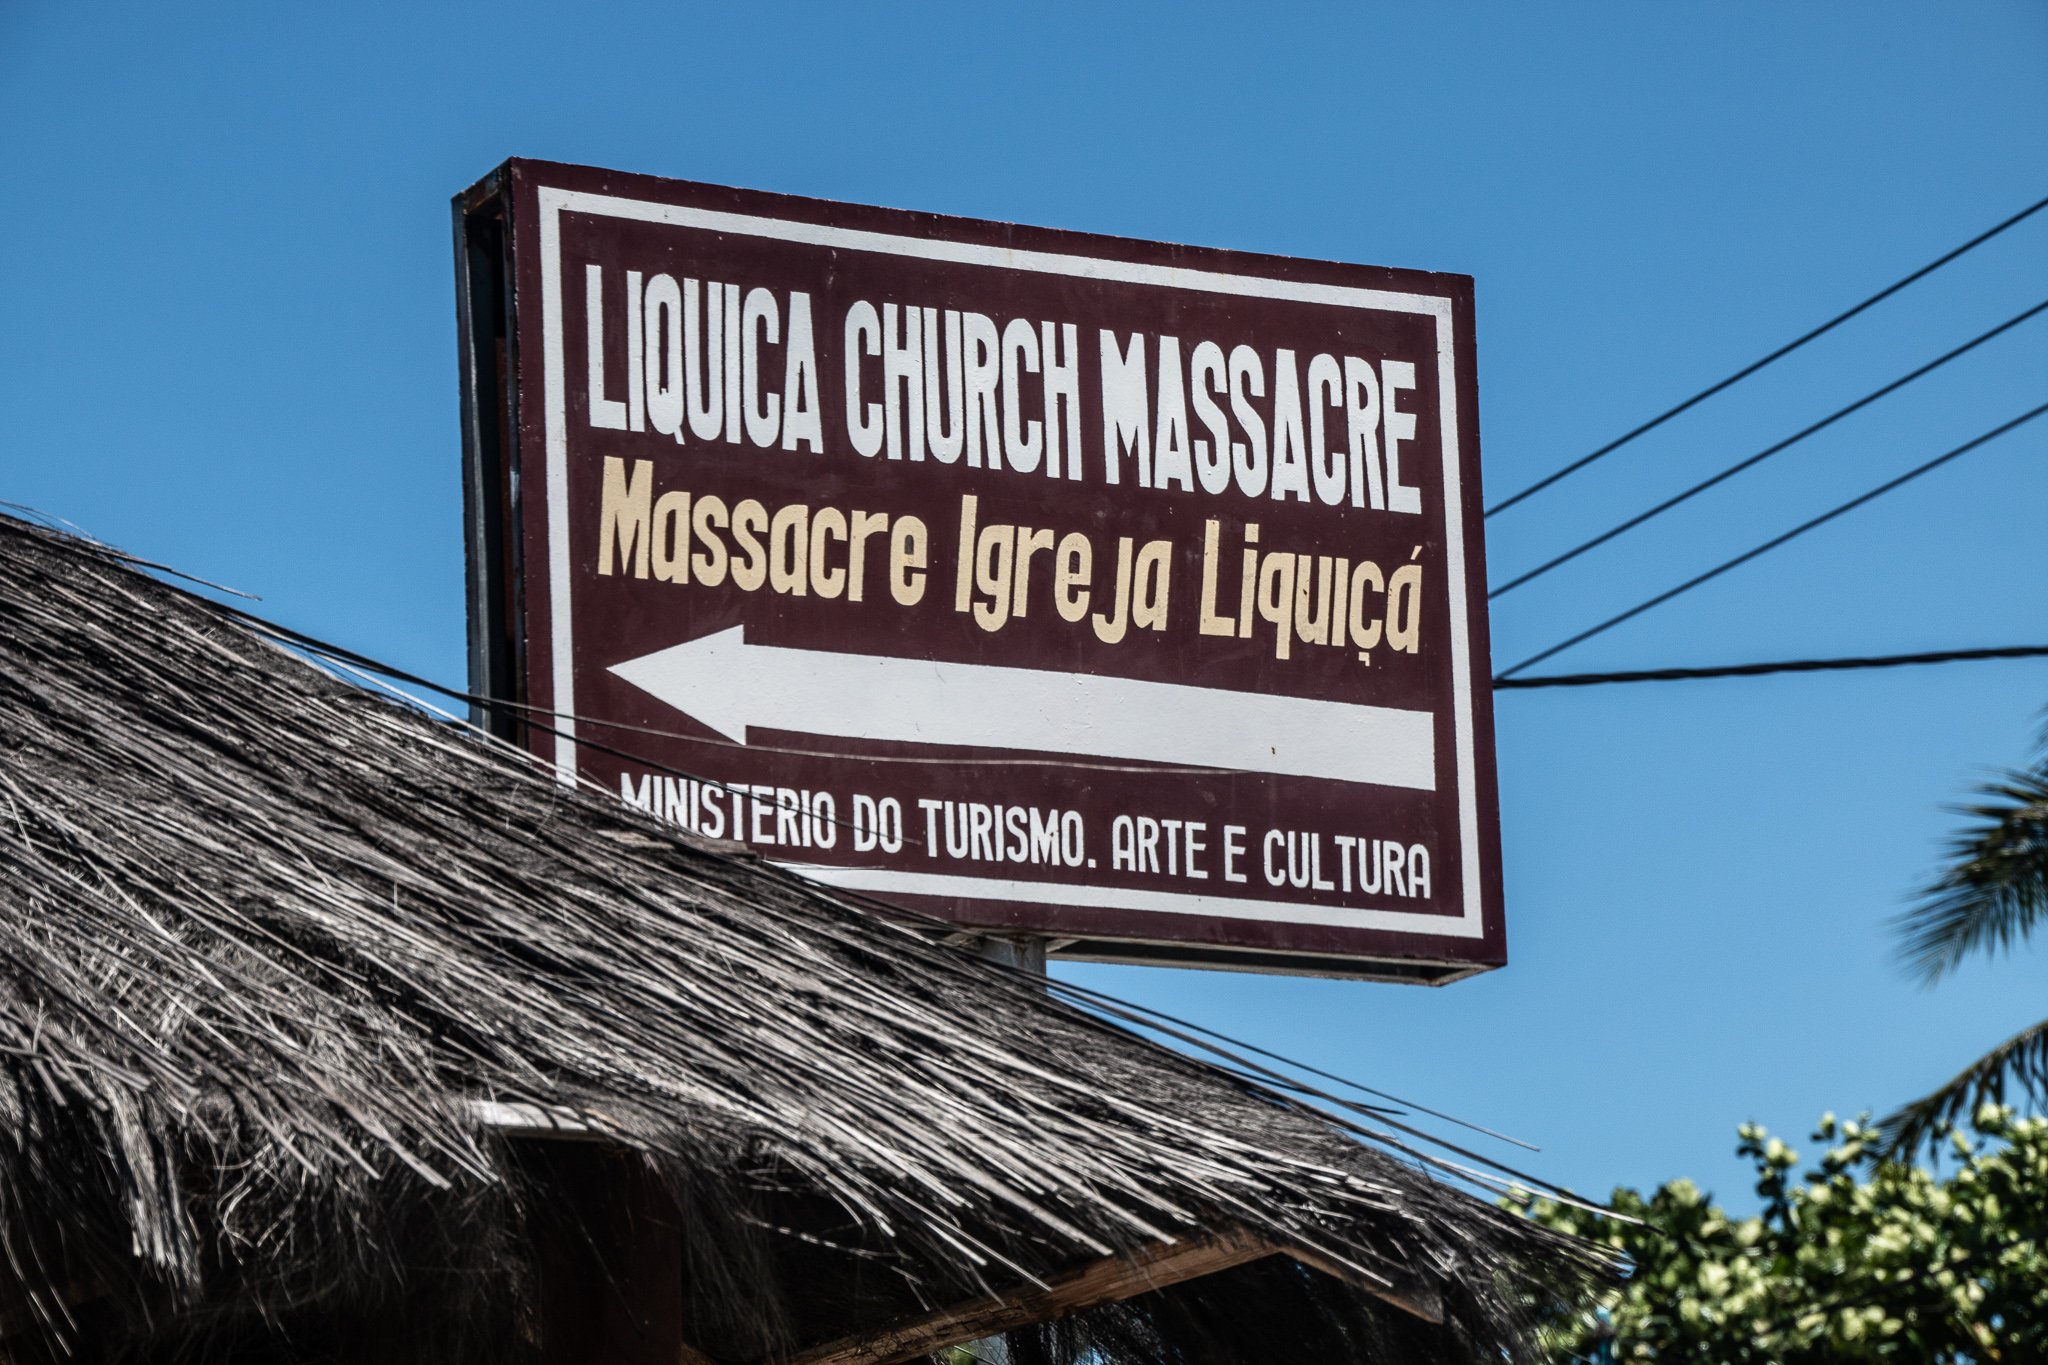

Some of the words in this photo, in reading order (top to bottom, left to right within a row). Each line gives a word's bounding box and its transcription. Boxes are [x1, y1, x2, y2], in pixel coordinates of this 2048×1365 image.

[585, 264, 825, 456] LIQUICA
[844, 299, 1084, 483] CHURCH
[1099, 328, 1423, 516] MASSACRE
[597, 455, 929, 607] Massacre
[852, 793, 904, 854] DO
[917, 798, 1097, 869] TURISMO.
[1111, 814, 1209, 880] ARTE
[1223, 824, 1248, 884] E
[1263, 828, 1433, 901] CULTURA
